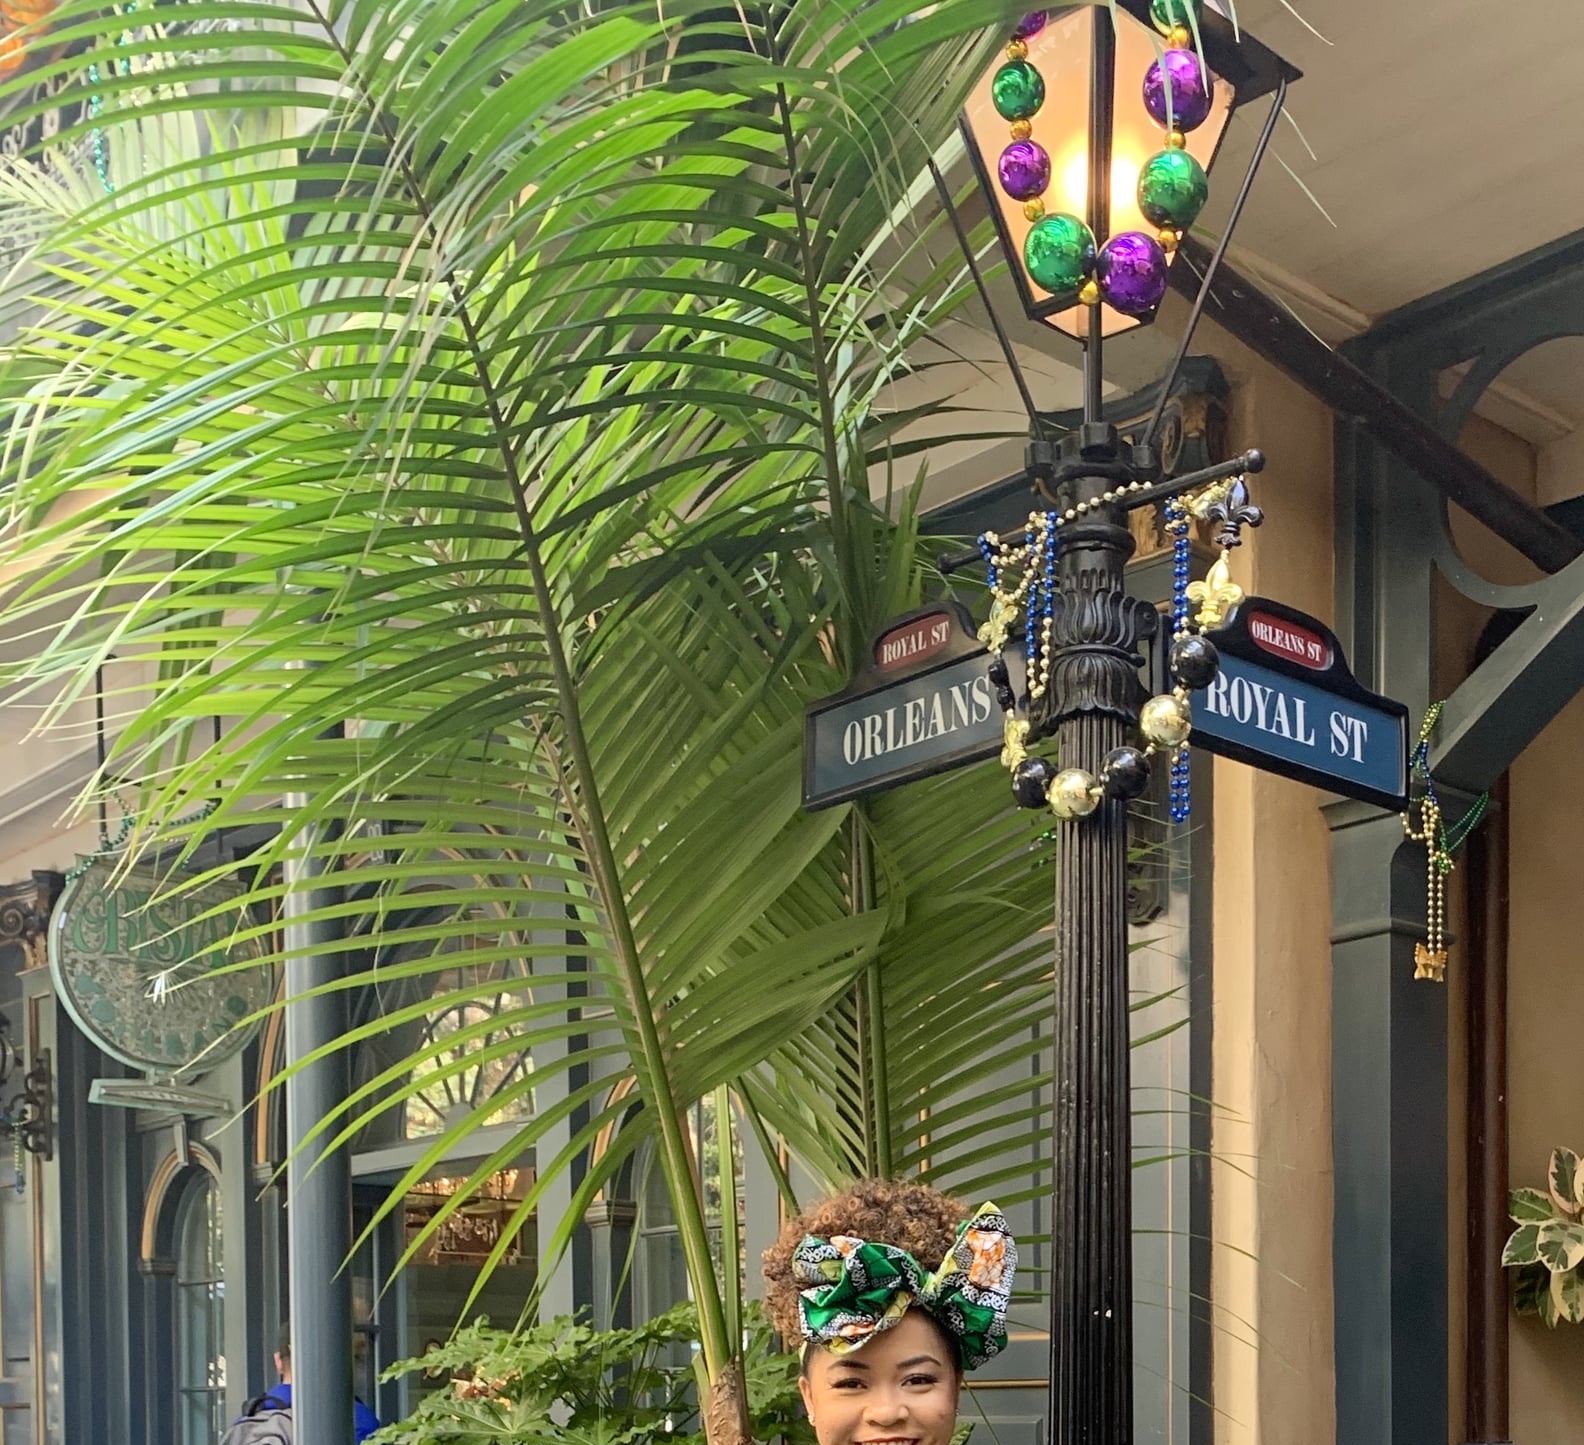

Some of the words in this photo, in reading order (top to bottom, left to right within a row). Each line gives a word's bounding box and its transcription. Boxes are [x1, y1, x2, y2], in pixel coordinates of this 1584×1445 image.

[883, 631, 927, 664] ROYAL
[930, 621, 949, 646] ST
[1251, 620, 1304, 656] ORLEANS
[1307, 640, 1322, 662] ST
[843, 674, 992, 766] ORLEANS
[1204, 670, 1316, 746] ROYAL
[1329, 711, 1368, 764] ST
